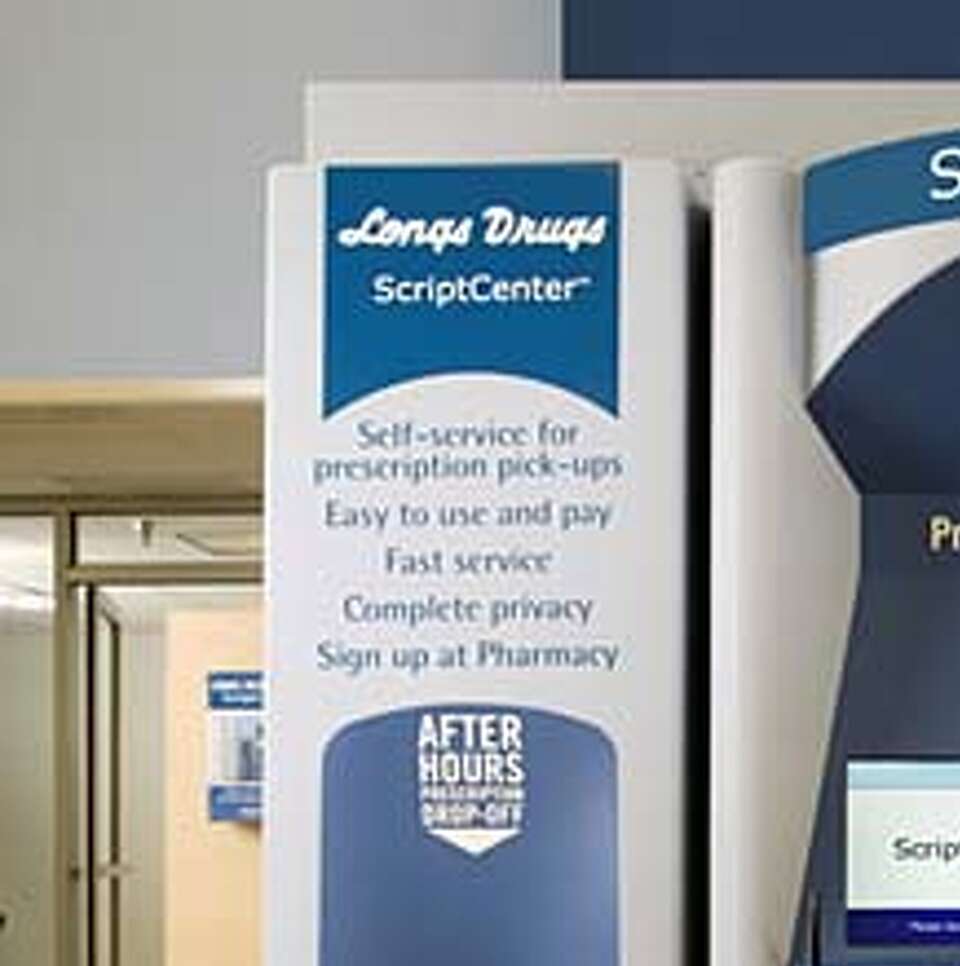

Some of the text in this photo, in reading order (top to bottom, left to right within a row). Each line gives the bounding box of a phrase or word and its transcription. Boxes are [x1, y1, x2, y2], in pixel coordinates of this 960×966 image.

[338, 205, 607, 252] Longs Drugs
[373, 274, 577, 307] ScriptCenter
[356, 420, 579, 448] Self-service for
[313, 452, 623, 484] prescription pick-ups
[324, 500, 612, 530] Easy to use and pay
[384, 548, 552, 573] Fast service
[343, 594, 593, 627] Complete privacy
[316, 641, 620, 675] Sign up at Pharmacy
[418, 714, 523, 750] AFTER
[418, 752, 526, 783] HOURS
